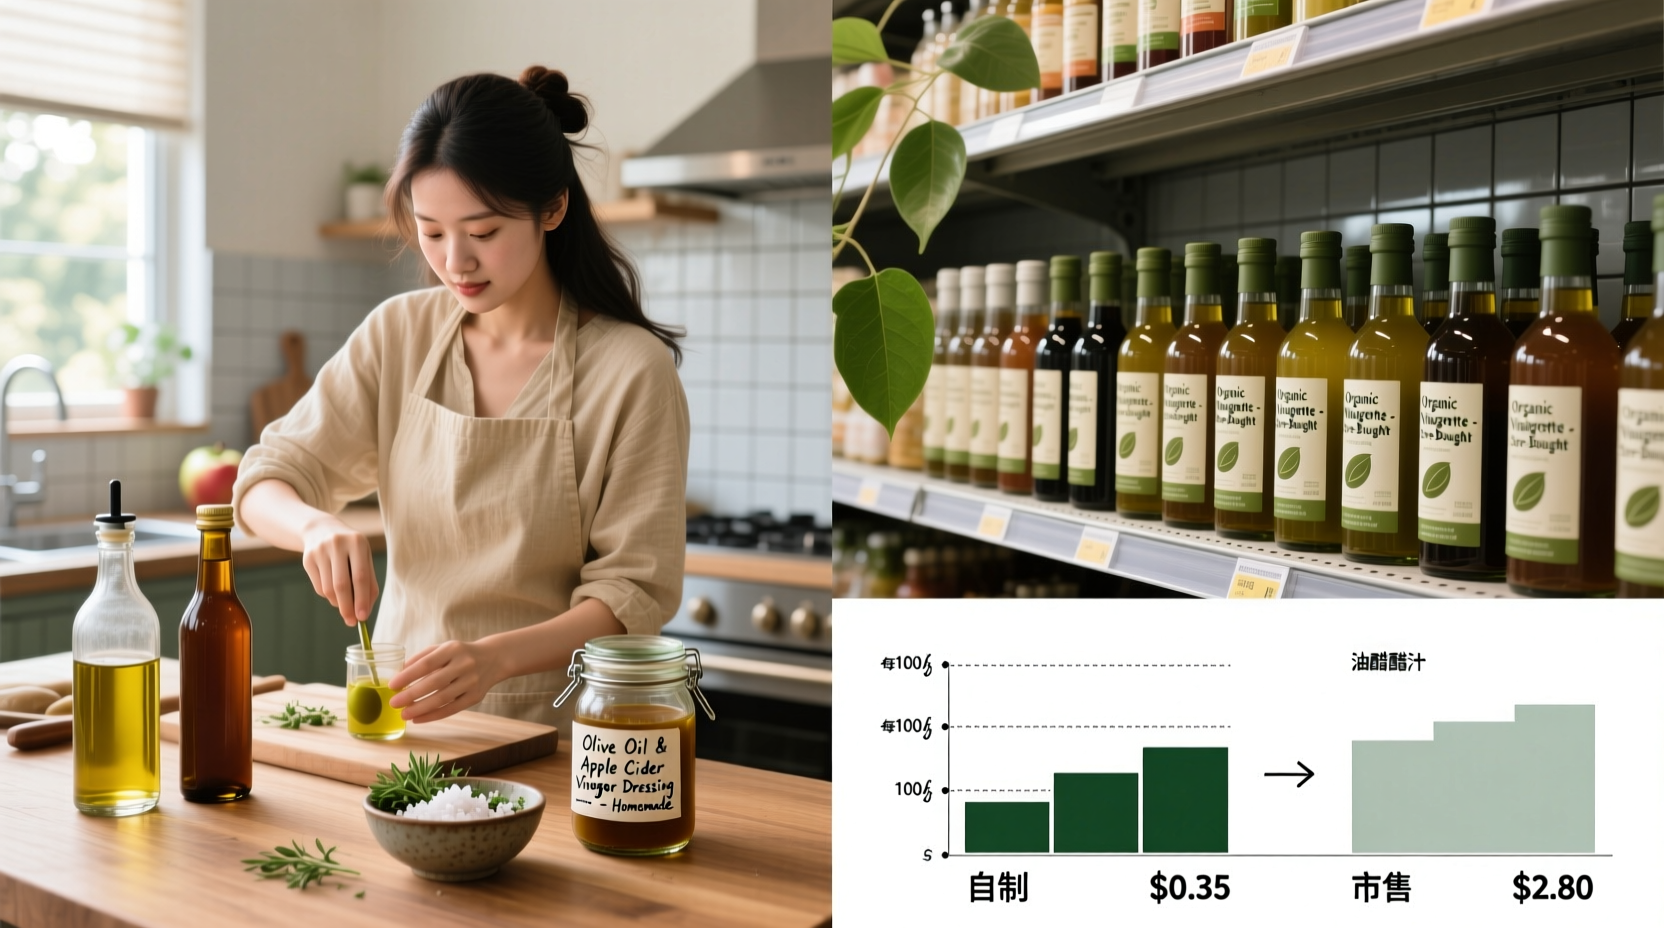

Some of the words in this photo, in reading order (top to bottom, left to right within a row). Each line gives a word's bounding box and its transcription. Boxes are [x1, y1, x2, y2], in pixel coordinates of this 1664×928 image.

[1511, 400, 1553, 417] Organic
[582, 734, 617, 754] Olive
[624, 738, 648, 755] Oil
[655, 736, 667, 754] &
[580, 755, 618, 778] Apple
[624, 759, 665, 775] Cider
